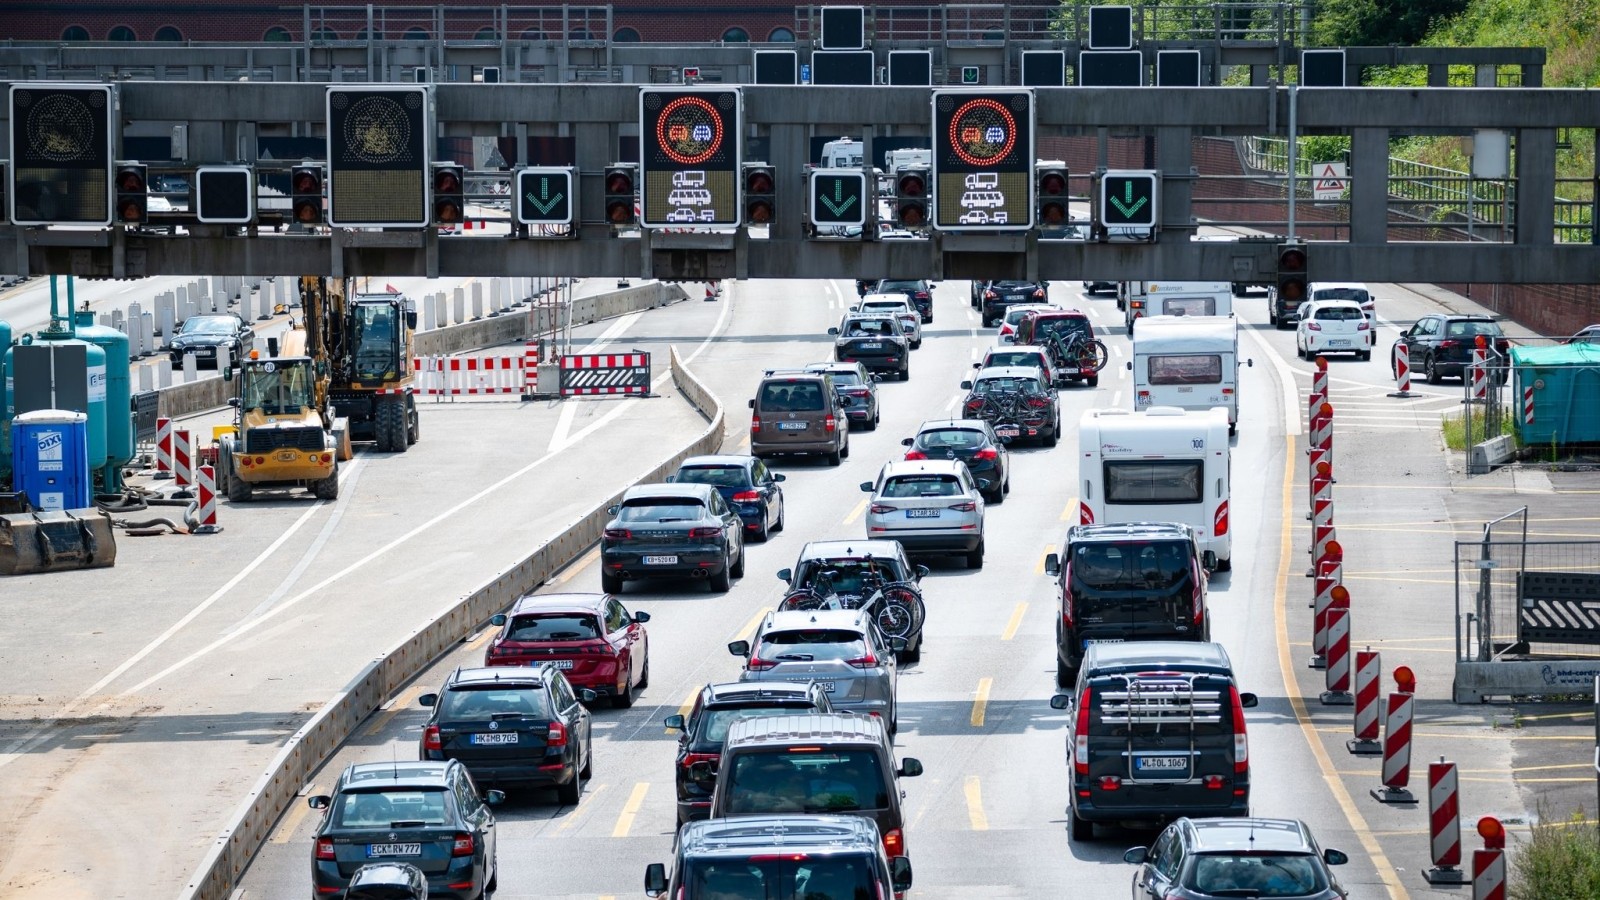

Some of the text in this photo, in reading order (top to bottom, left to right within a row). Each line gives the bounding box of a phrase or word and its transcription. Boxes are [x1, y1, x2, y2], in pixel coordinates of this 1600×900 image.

[266, 363, 275, 373] 20
[38, 434, 62, 450] DIXI
[1192, 439, 1203, 449] 100
[557, 660, 573, 668] 1212
[476, 734, 517, 743] HK MB 705
[1142, 758, 1187, 768] WL OL 1067
[372, 844, 420, 854] ECK RW 777
